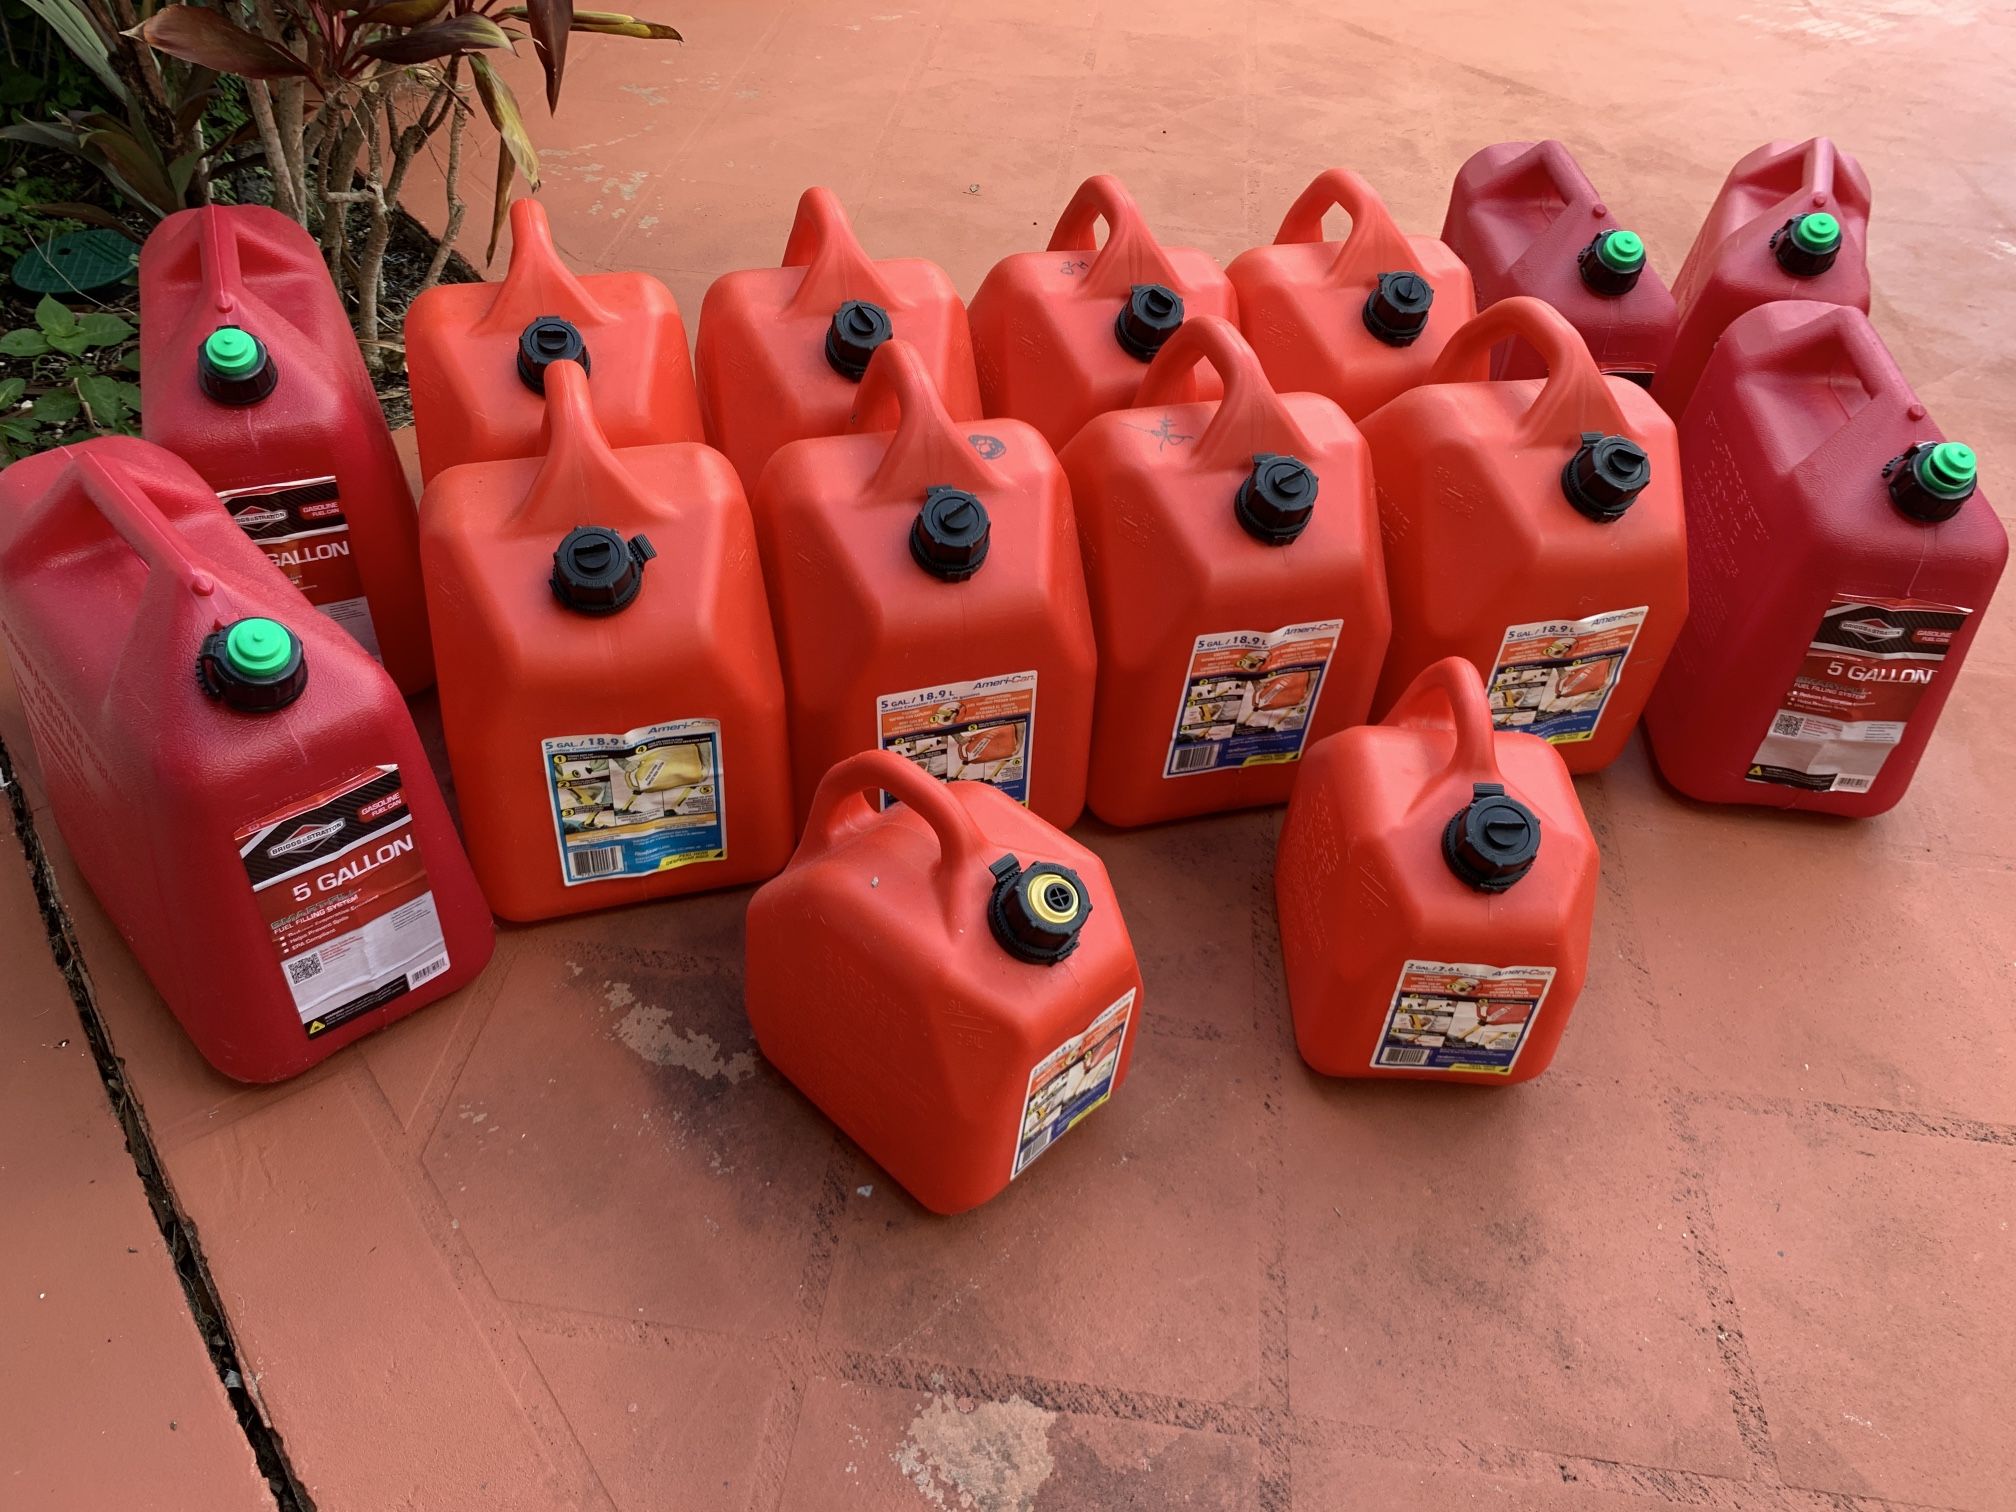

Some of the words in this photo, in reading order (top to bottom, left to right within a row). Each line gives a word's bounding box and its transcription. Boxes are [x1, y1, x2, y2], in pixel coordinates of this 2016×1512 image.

[302, 501, 339, 513] GASOLINE
[266, 540, 350, 567] GALLON
[1508, 630, 1516, 639] 5
[1542, 625, 1568, 634] 18.9
[1916, 629, 1953, 638] GASOLINE
[1197, 640, 1206, 649] 5
[1233, 635, 1260, 645] 18.9
[1826, 660, 1845, 676] 5
[1847, 664, 1934, 685] GALLON
[881, 700, 889, 709] 5
[919, 689, 946, 702] 18.9
[545, 741, 554, 750] 5
[588, 737, 619, 746] 18.9
[361, 792, 401, 816] GASOLINE
[371, 806, 388, 817] FUEL
[386, 799, 402, 811] CAN
[292, 882, 312, 902] 5
[316, 834, 414, 892] GALLON
[273, 923, 294, 935] FUEL
[295, 908, 326, 925] FILLING
[326, 894, 359, 913] SYSTEM
